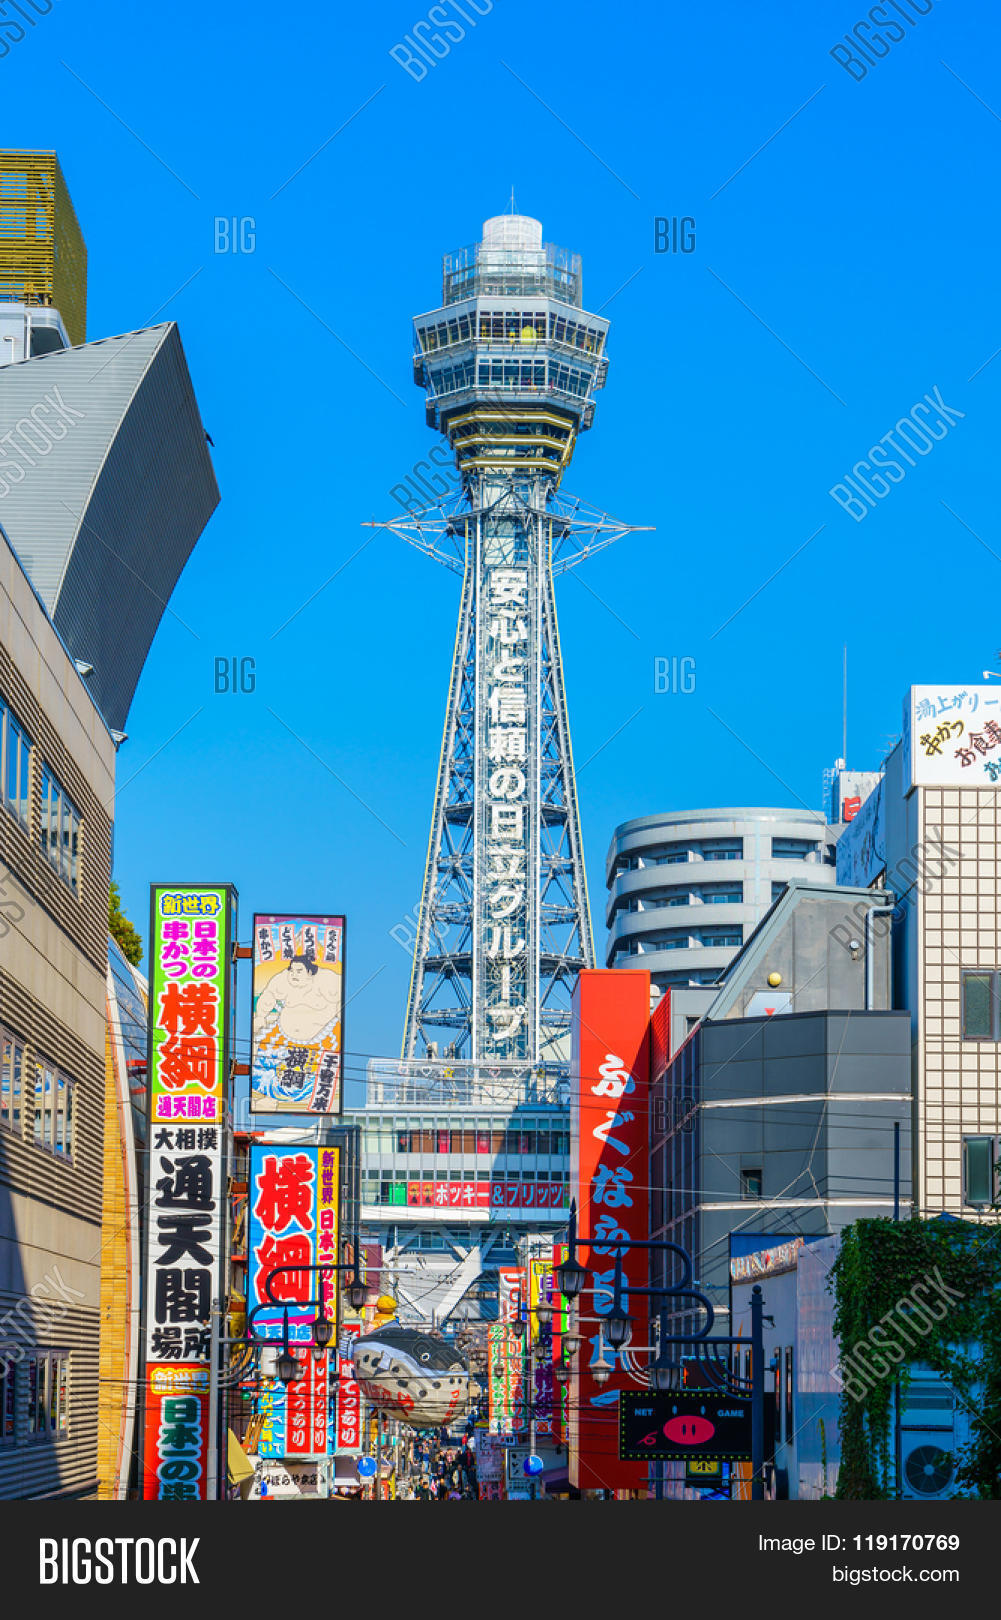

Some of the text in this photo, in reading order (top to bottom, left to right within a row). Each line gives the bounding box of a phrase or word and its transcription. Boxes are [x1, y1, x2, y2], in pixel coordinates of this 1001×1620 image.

[488, 568, 528, 1040] 安心と信頼の日立グループ
[161, 894, 221, 915] 新世界
[161, 919, 190, 979] 串かつ
[190, 919, 218, 979] 日本一の
[157, 981, 220, 1091] 横綱
[156, 1094, 218, 1118] 通天閣店
[154, 1126, 218, 1151] 大相撲
[152, 1154, 216, 1325] 通天閣
[254, 1152, 315, 1314] 横綱
[318, 1150, 336, 1319] 新世界 日本一の串か
[151, 1326, 212, 1360] 場所
[634, 1408, 745, 1418] NET GAME
